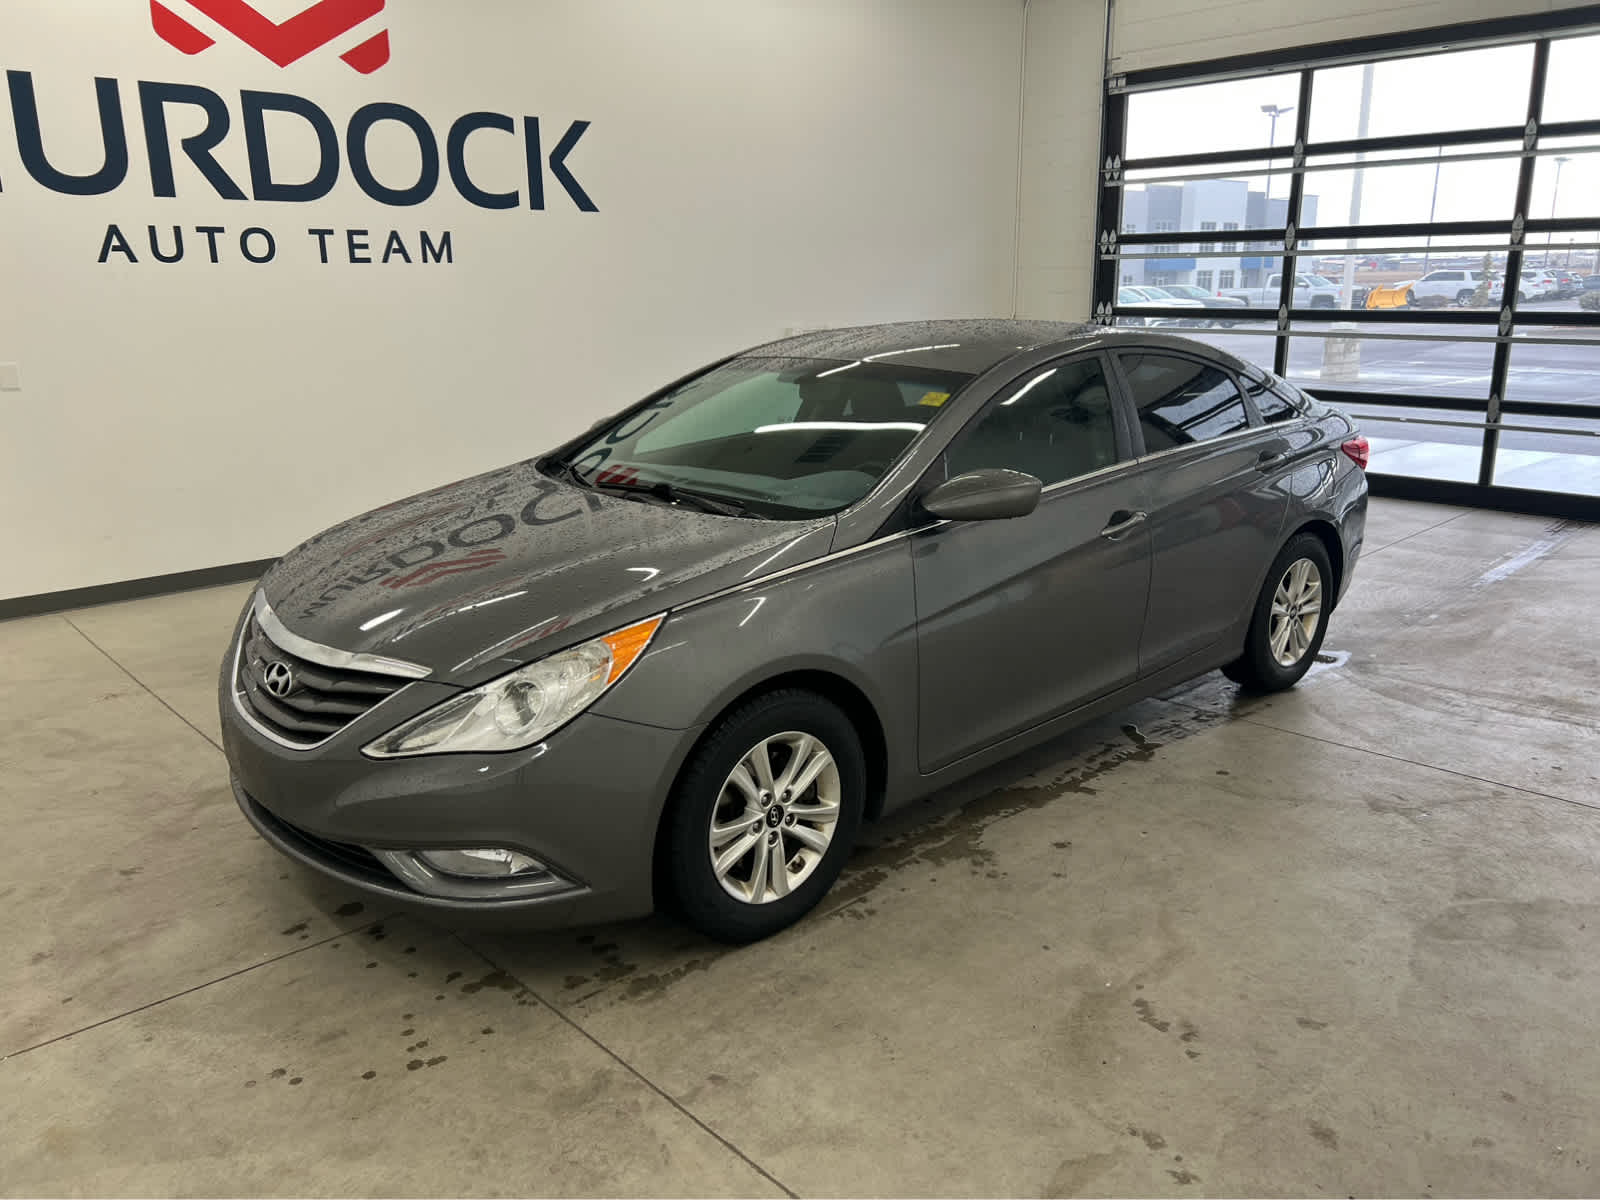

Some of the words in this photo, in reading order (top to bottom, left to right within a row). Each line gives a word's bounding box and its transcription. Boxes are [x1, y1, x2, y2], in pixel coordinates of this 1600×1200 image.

[0, 70, 600, 213] URDOCK
[97, 224, 276, 264] AUTO
[307, 228, 454, 264] TEAM
